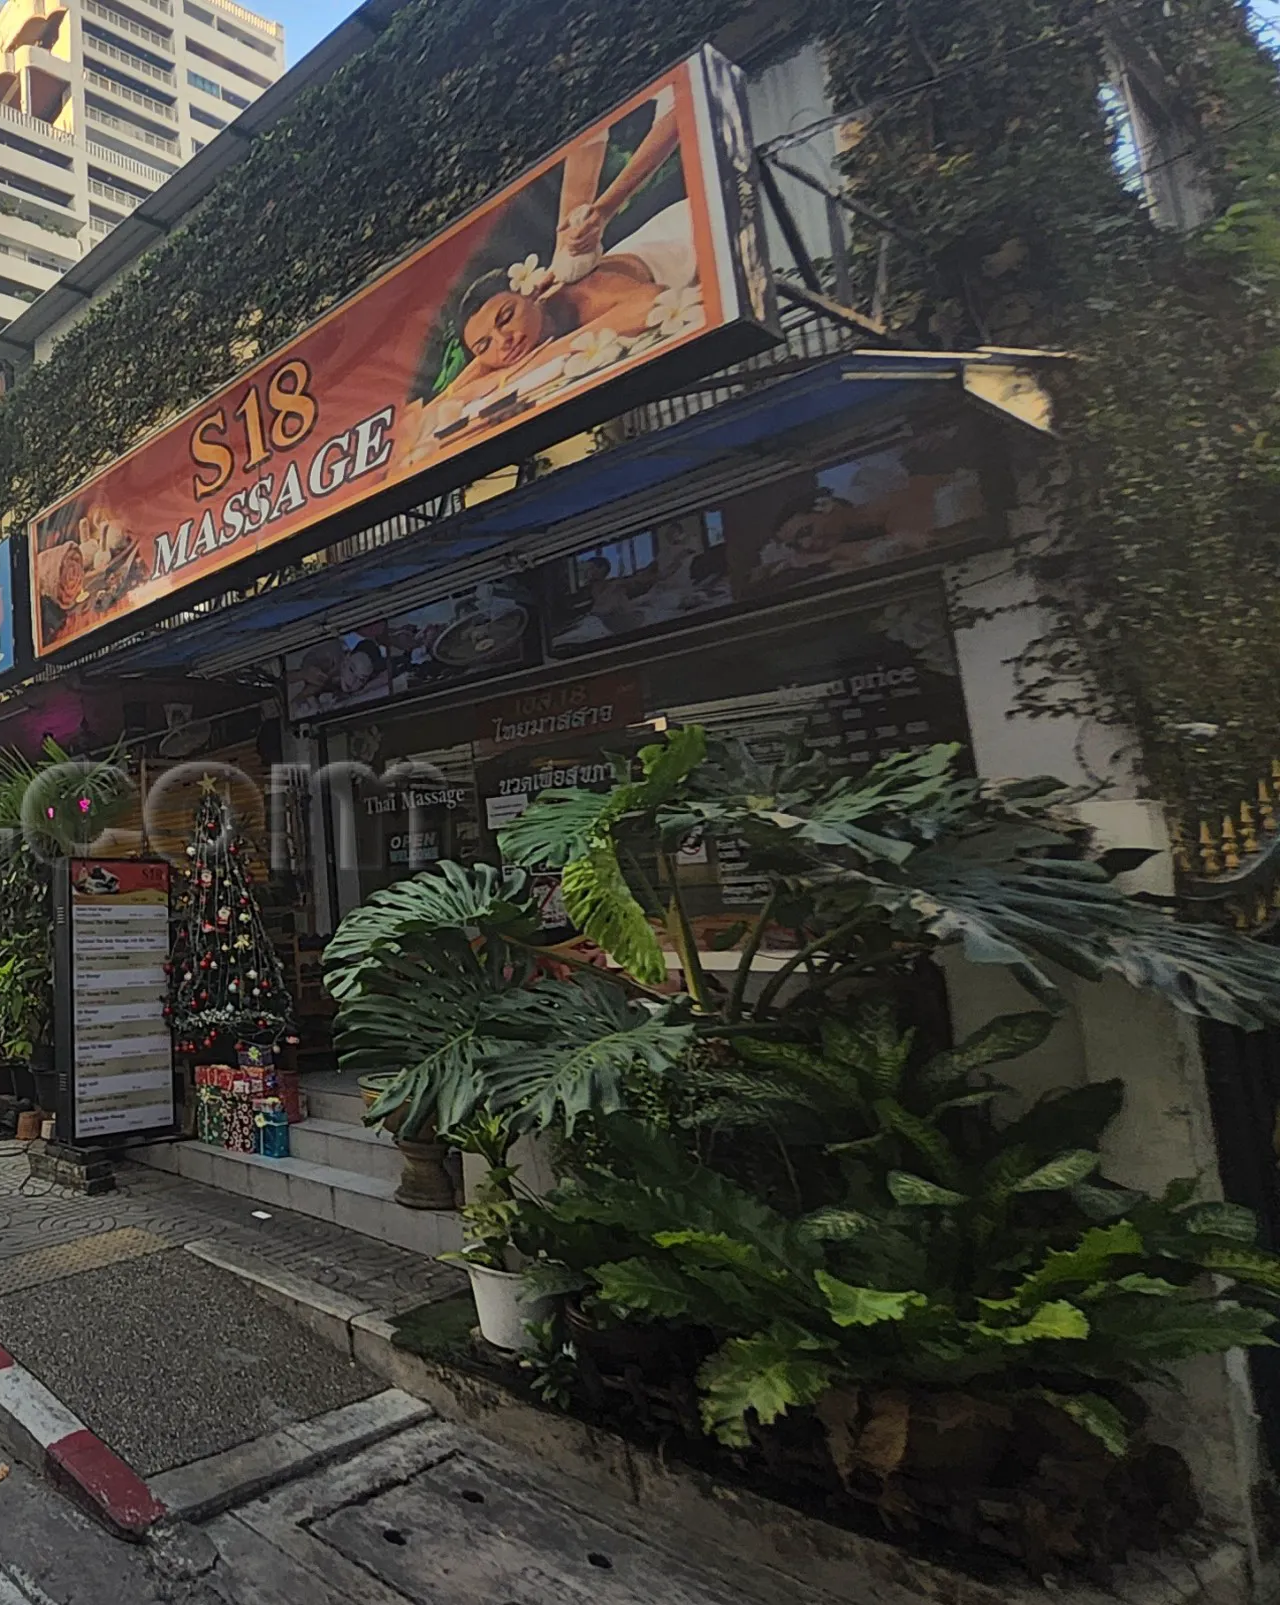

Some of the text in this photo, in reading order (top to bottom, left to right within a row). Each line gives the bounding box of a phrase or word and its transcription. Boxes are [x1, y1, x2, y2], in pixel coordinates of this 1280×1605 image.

[190, 357, 319, 502] S18
[150, 405, 397, 582] MASSAGE
[849, 661, 918, 697] price
[363, 788, 465, 815] Thai Massage
[389, 831, 438, 850] OPEN
